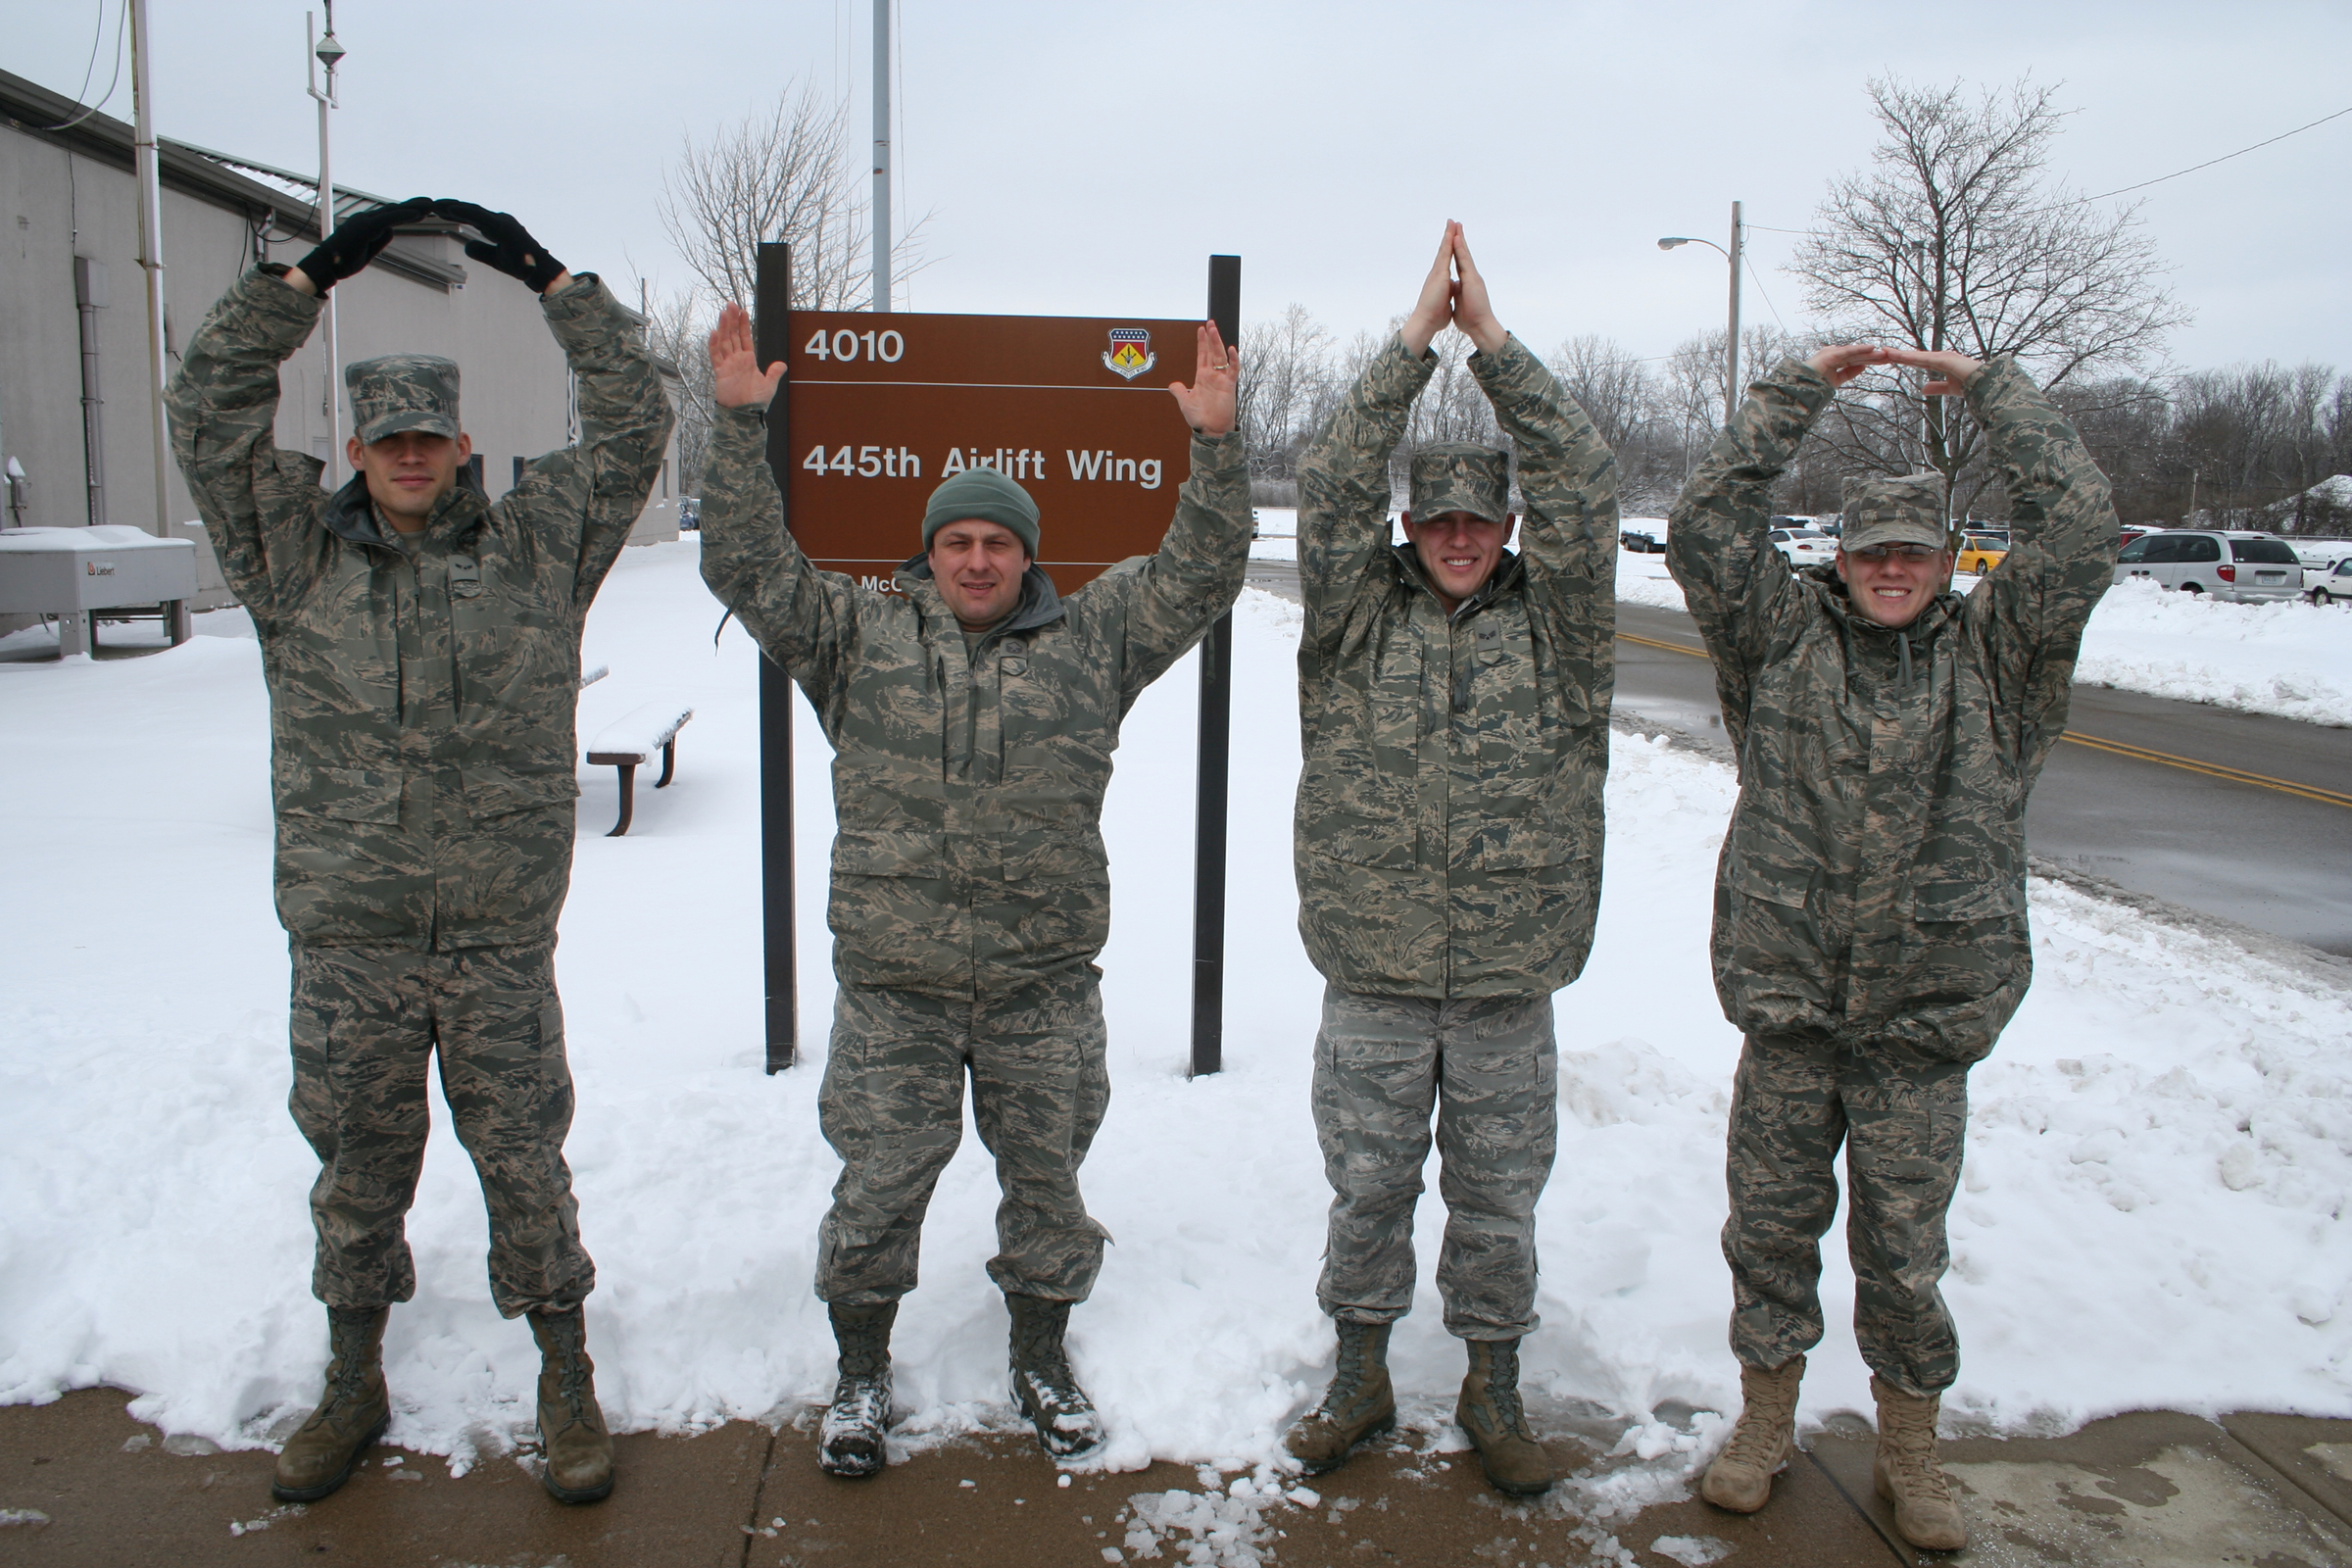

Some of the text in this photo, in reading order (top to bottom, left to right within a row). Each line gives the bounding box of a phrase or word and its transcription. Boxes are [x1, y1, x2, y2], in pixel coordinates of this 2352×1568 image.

[805, 329, 905, 363] 4010
[803, 445, 920, 477] 445th
[1066, 450, 1161, 489] Wing
[96, 565, 116, 576] Liebert
